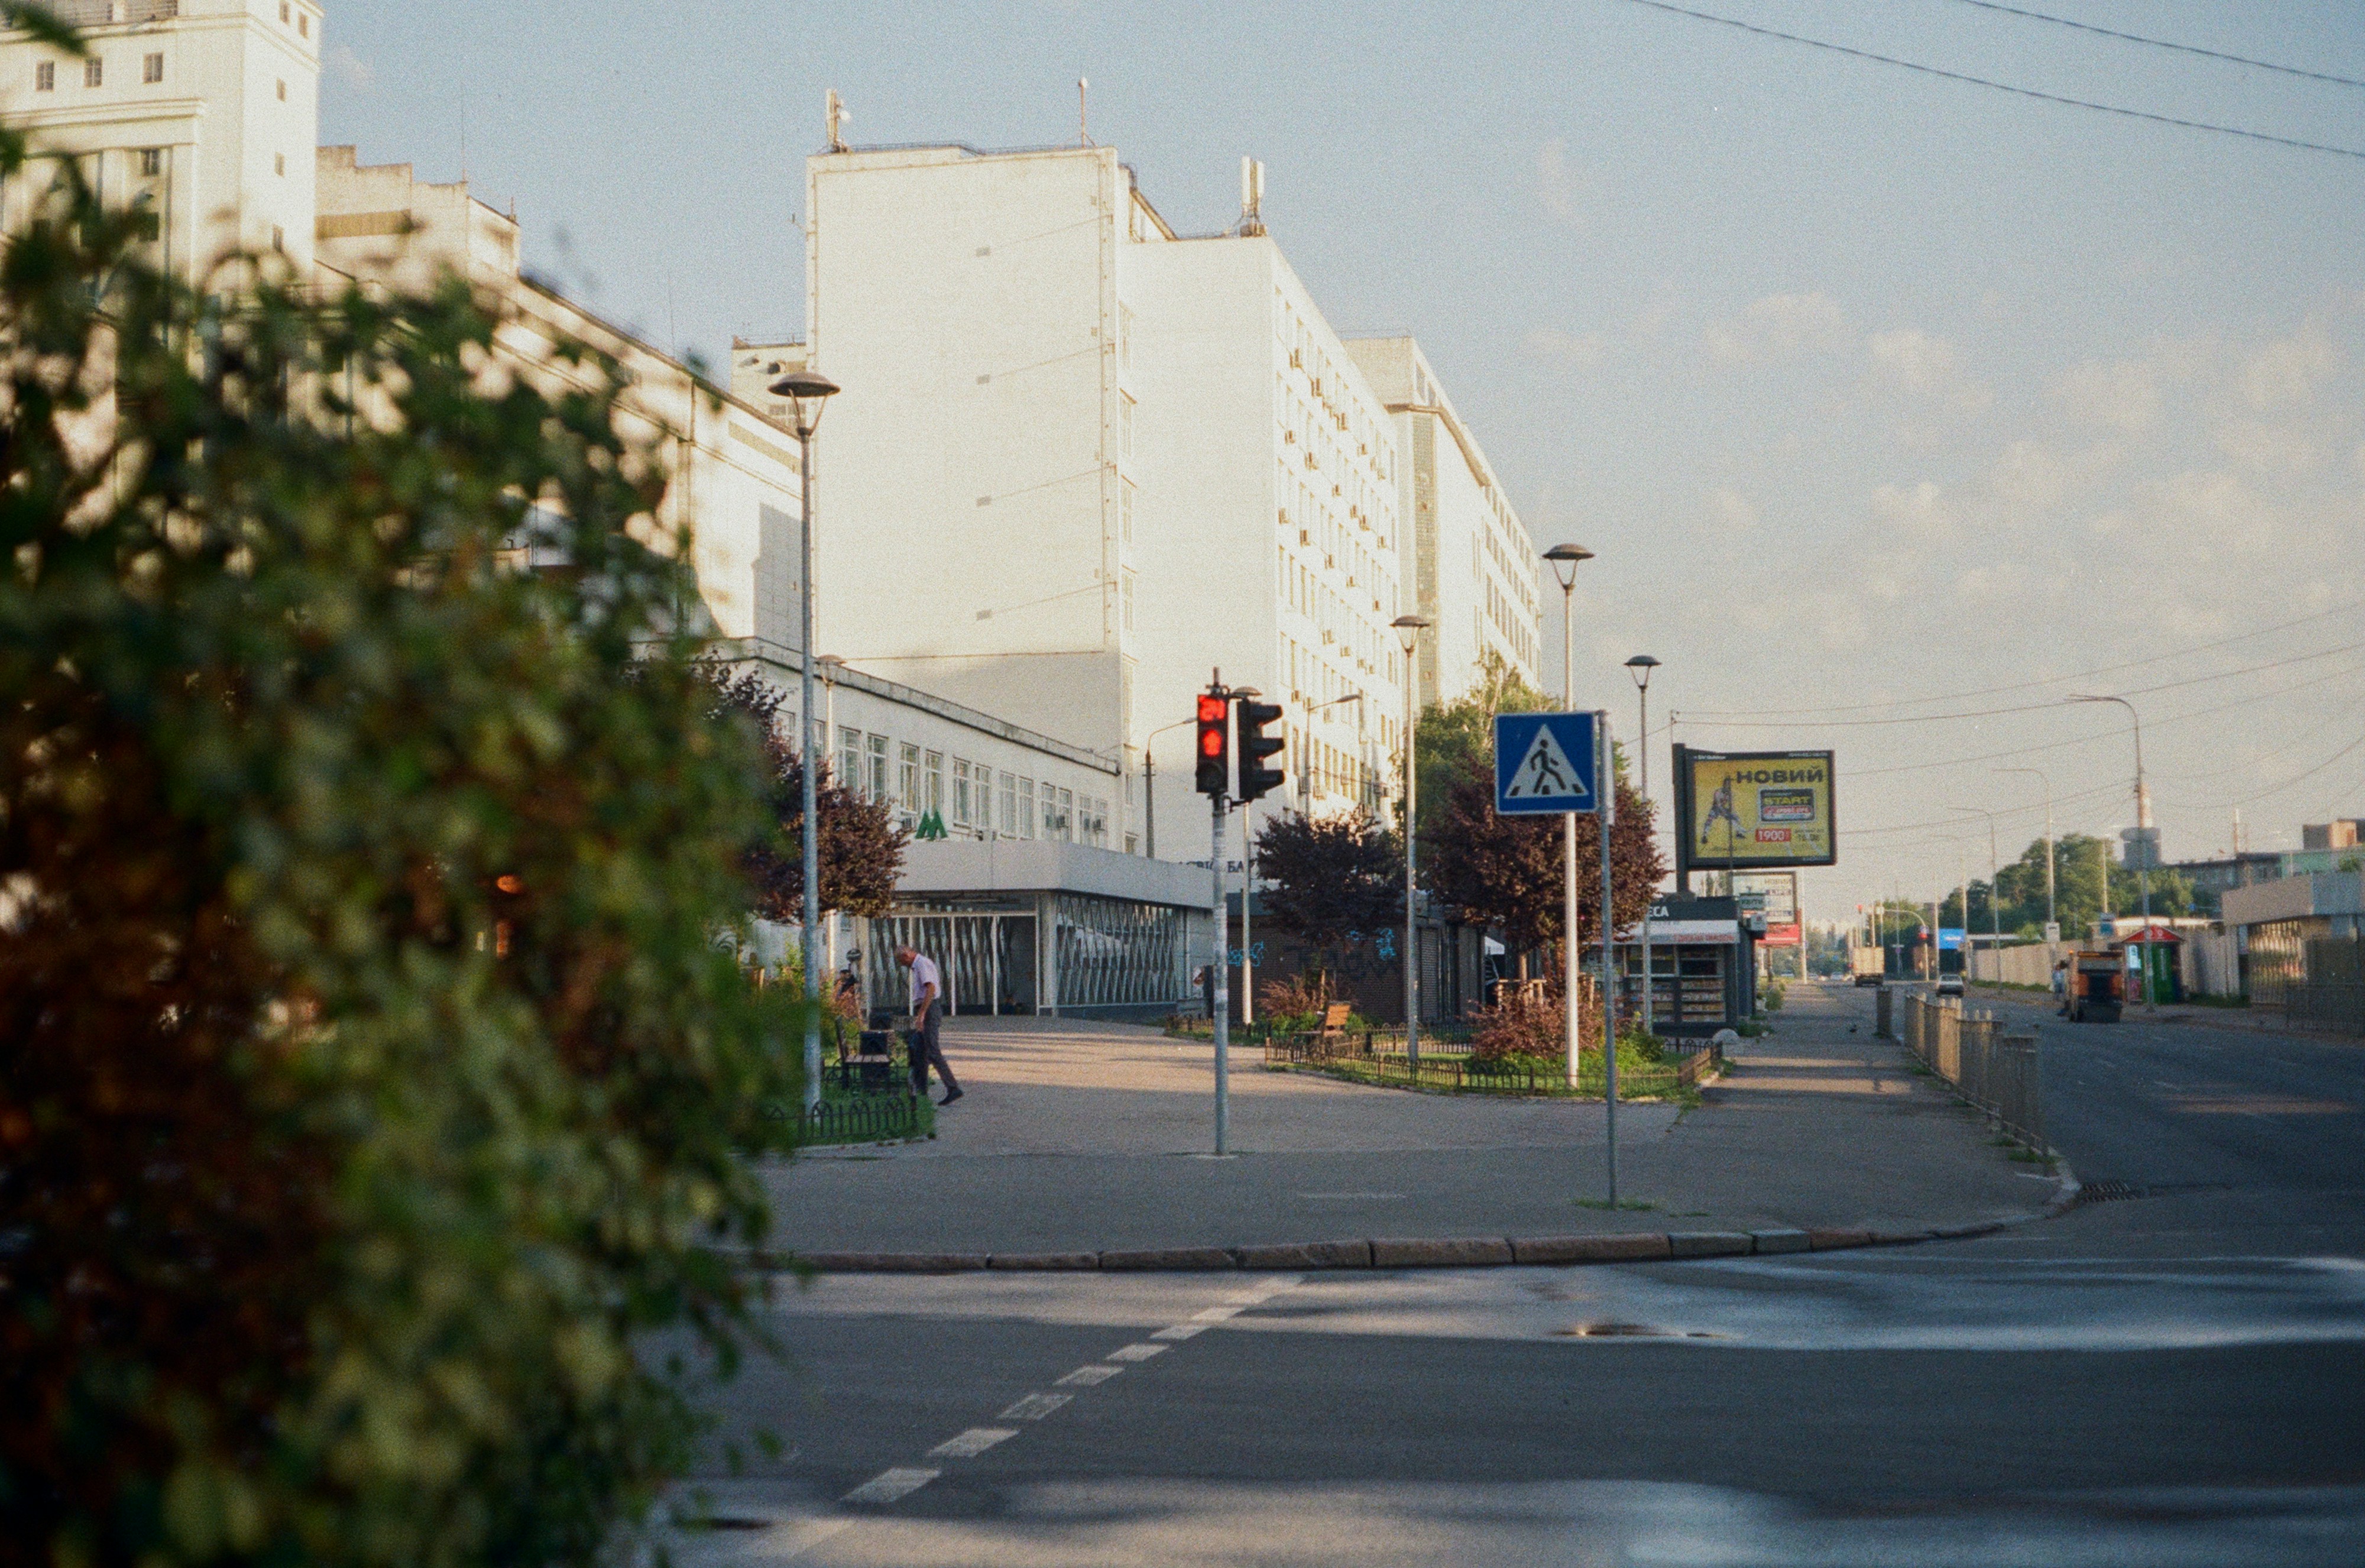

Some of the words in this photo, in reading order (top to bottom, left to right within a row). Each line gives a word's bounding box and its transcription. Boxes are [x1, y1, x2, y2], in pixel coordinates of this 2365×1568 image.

[1737, 765, 1823, 783] НОВИЙ
[1763, 796, 1810, 805] START
[1648, 906, 1669, 917] ЕСА
